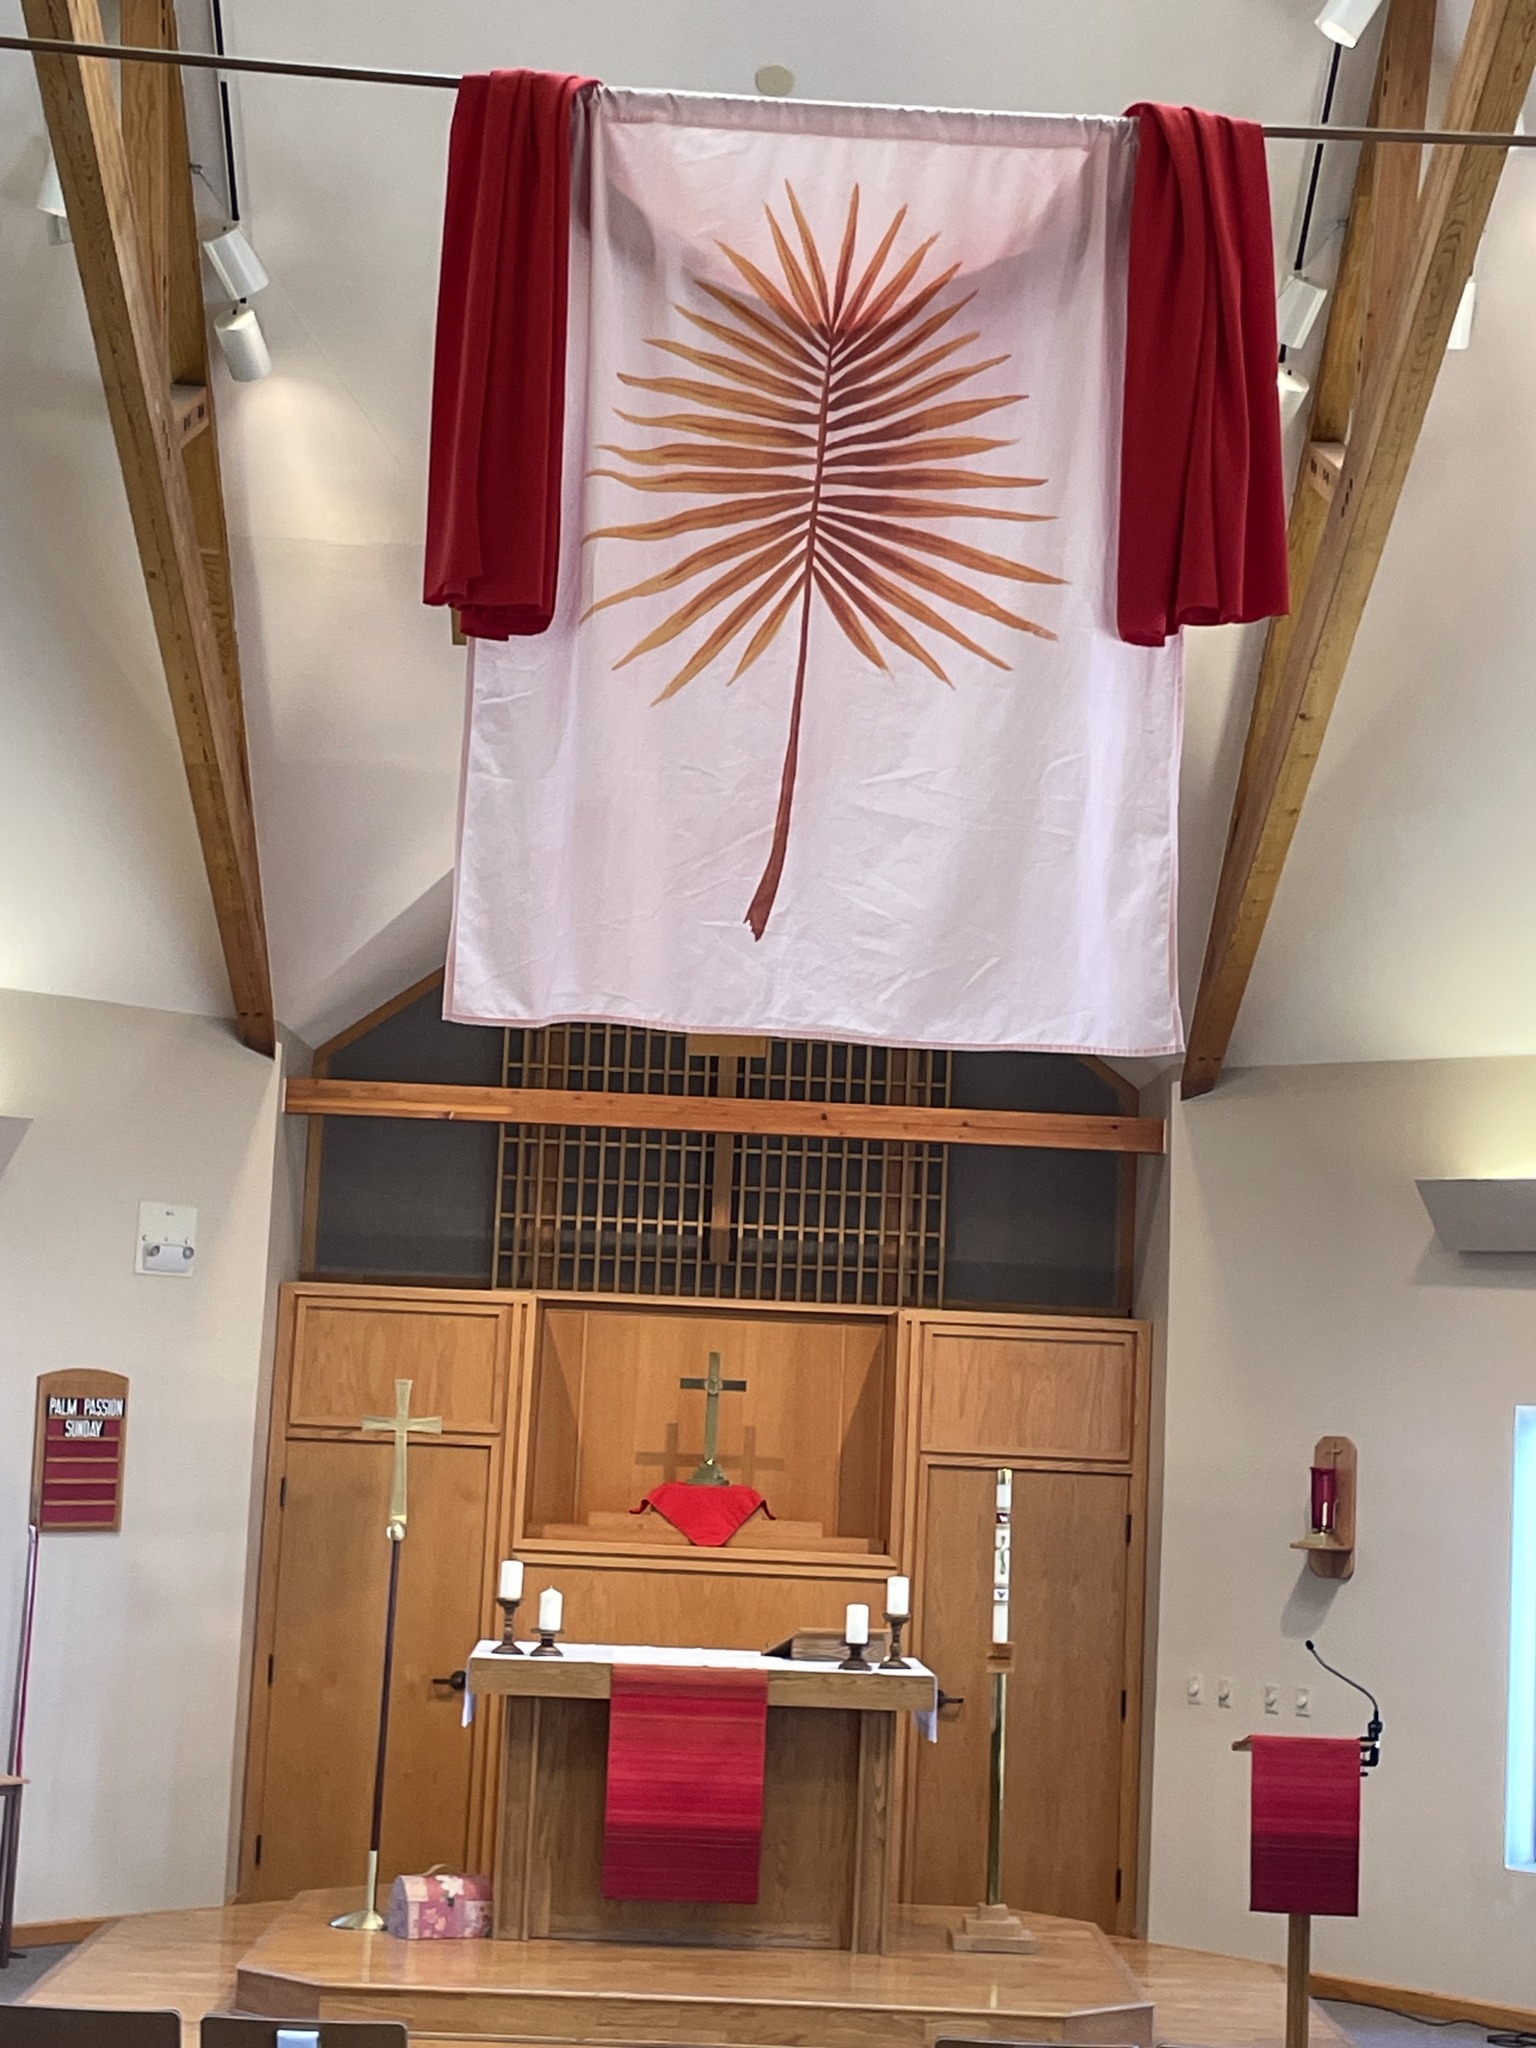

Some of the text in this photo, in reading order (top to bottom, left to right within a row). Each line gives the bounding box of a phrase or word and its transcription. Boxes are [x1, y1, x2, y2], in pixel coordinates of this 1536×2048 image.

[49, 1398, 124, 1417] PALM PASSION
[65, 1420, 103, 1437] SUNDAY
